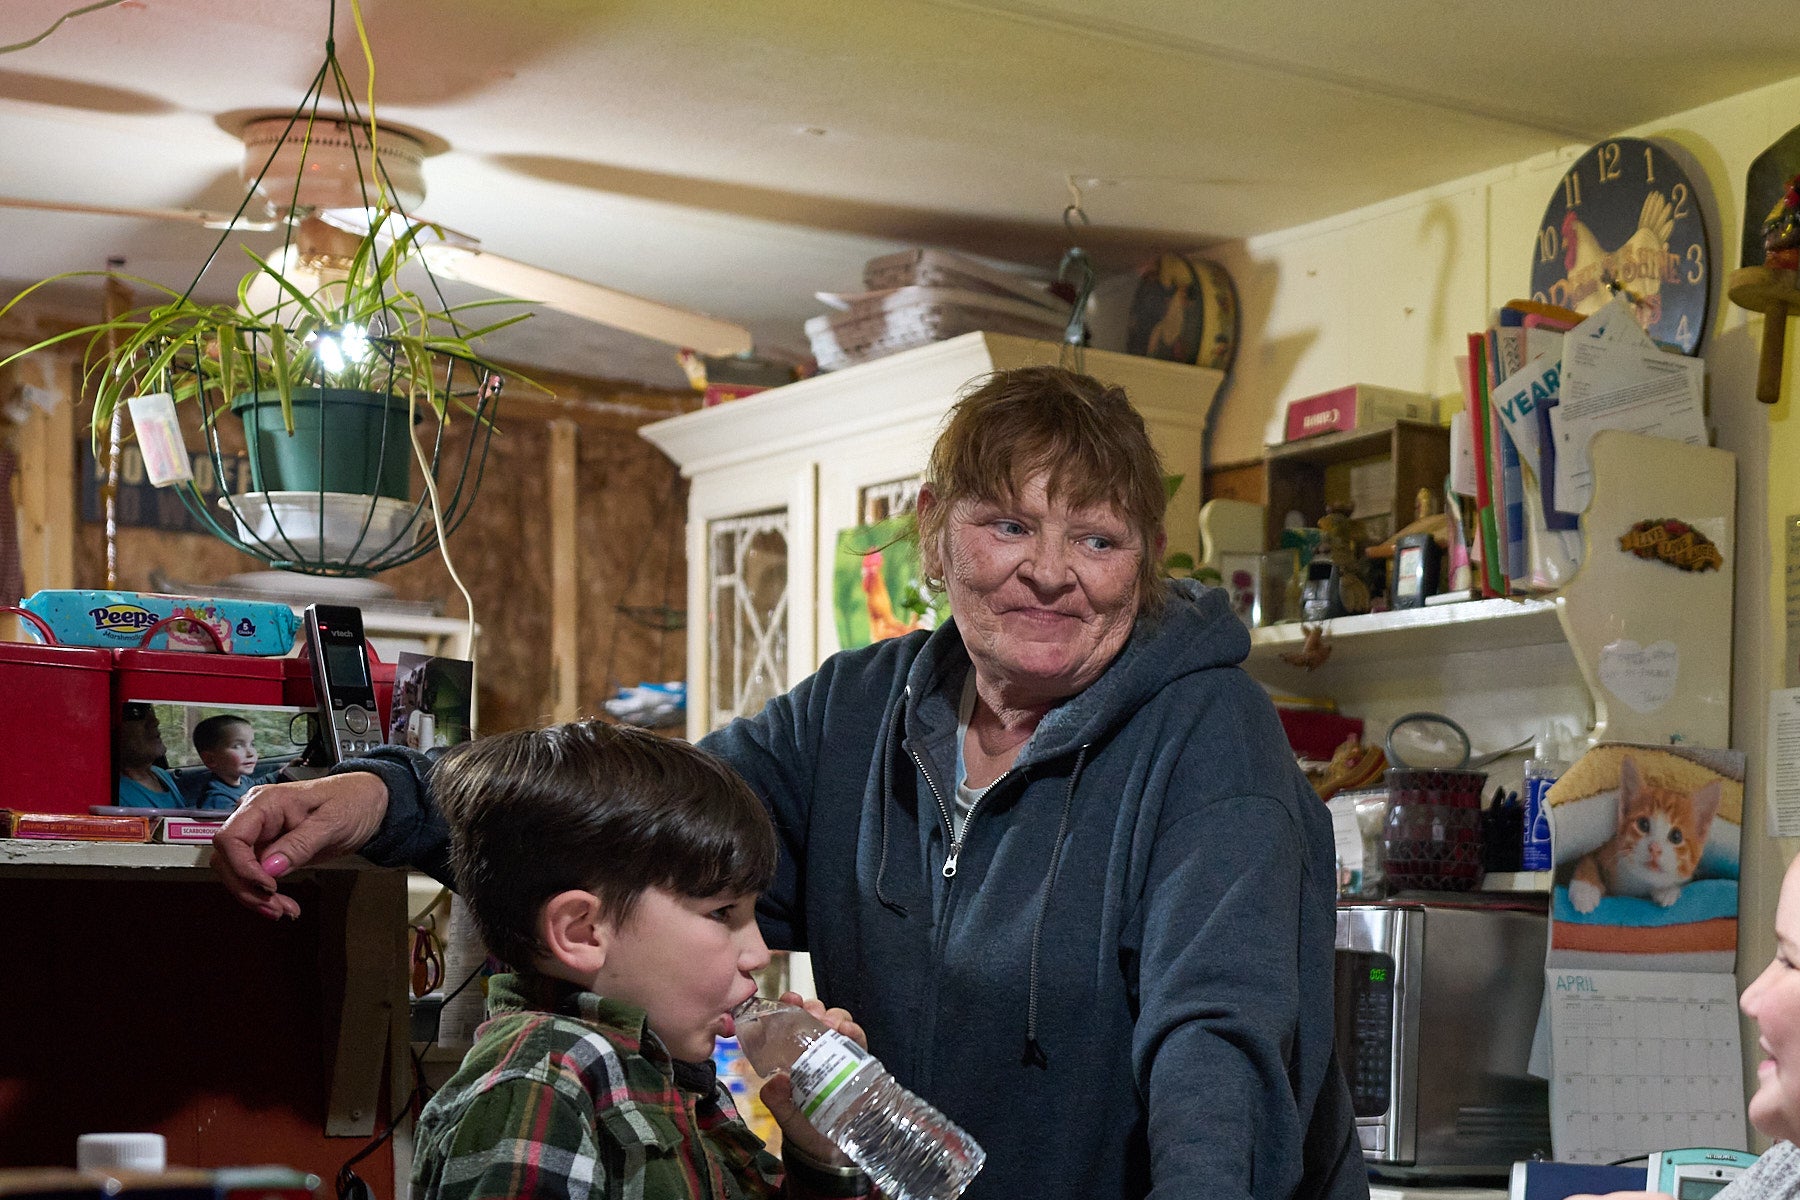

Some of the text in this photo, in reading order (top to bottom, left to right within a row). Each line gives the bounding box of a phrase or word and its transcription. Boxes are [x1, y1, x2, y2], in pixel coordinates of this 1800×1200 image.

[1598, 143, 1621, 183] 12
[1644, 147, 1655, 183] 1
[1565, 171, 1582, 208] 11
[1672, 183, 1688, 219] 2
[1540, 226, 1559, 263] 10
[1687, 244, 1704, 284] 3
[1675, 314, 1693, 349] 4
[1500, 359, 1562, 424] YEAR
[1303, 408, 1340, 429] Canon
[89, 607, 160, 630] Peeps
[102, 630, 146, 642] Marshmallo
[243, 623, 249, 631] 5
[182, 827, 220, 835] SCARBOROUG
[1556, 975, 1599, 992] APRIL
